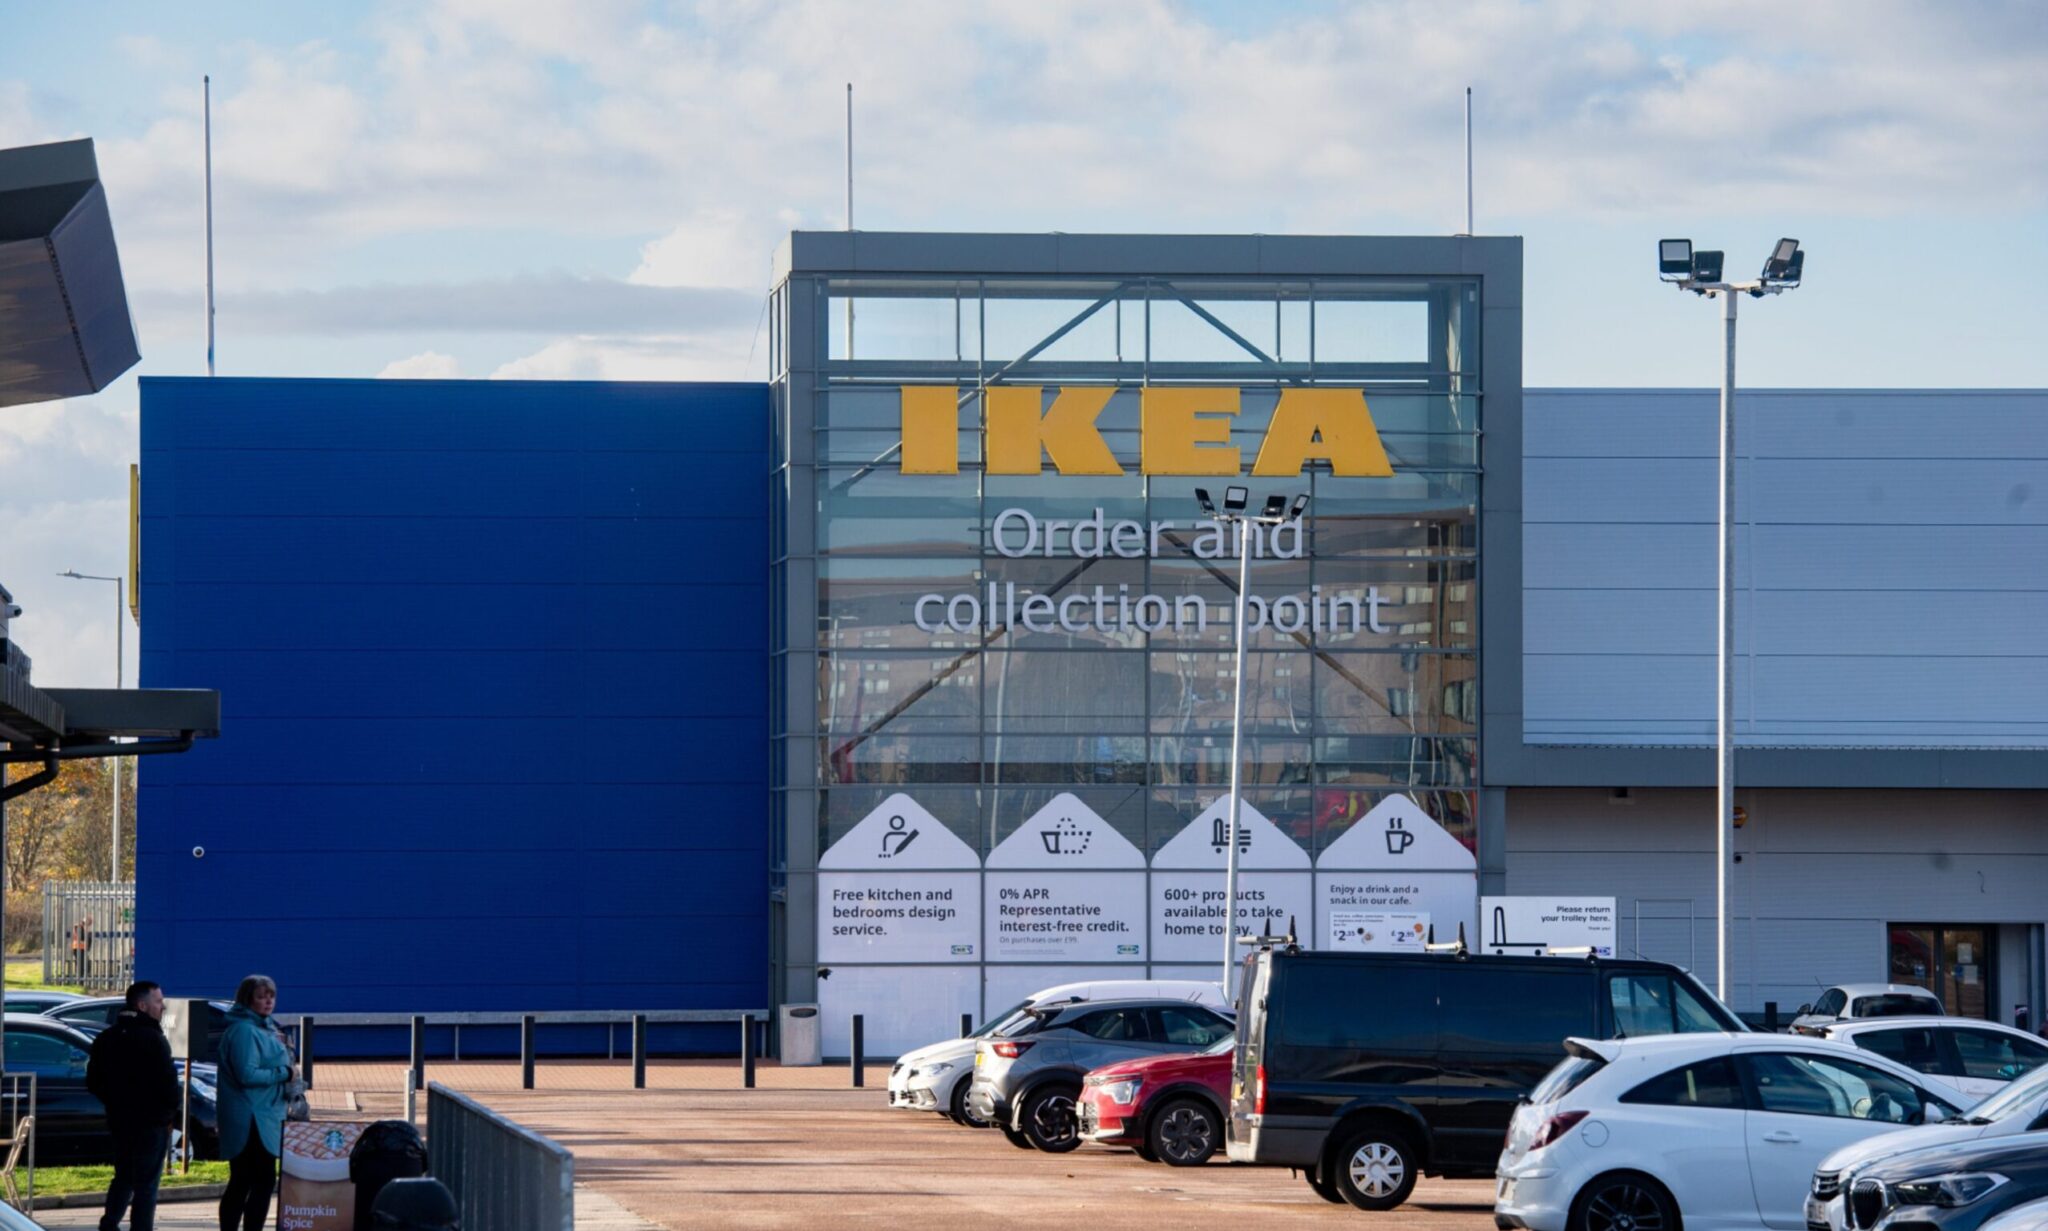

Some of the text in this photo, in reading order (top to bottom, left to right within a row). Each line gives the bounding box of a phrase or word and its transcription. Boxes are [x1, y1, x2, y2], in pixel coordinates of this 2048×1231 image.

[900, 385, 1395, 477] IKEA
[992, 508, 1303, 559] Order and
[914, 582, 1391, 643] collection point
[833, 888, 953, 901] Free kitchen and
[999, 888, 1050, 900] 0% APR
[1164, 889, 1265, 903] 600+ proucts
[1330, 885, 1356, 895] Enjoy
[1365, 885, 1391, 893] drink
[1392, 885, 1411, 893] and
[1329, 896, 1358, 904] snack
[1359, 896, 1369, 904] in
[1389, 896, 1412, 904] cafe.
[832, 905, 956, 921] bedrooms design
[999, 904, 1101, 918] Representative
[1164, 906, 1228, 918] available
[1251, 906, 1284, 918] take
[1561, 914, 1587, 922] trolley
[832, 923, 888, 936] service.
[999, 920, 1130, 932] interest-free credit.
[1164, 923, 1253, 937] home toay.
[1011, 936, 1046, 944] purchases
[284, 1205, 336, 1217] Pumpkin
[283, 1217, 314, 1230] Spice
